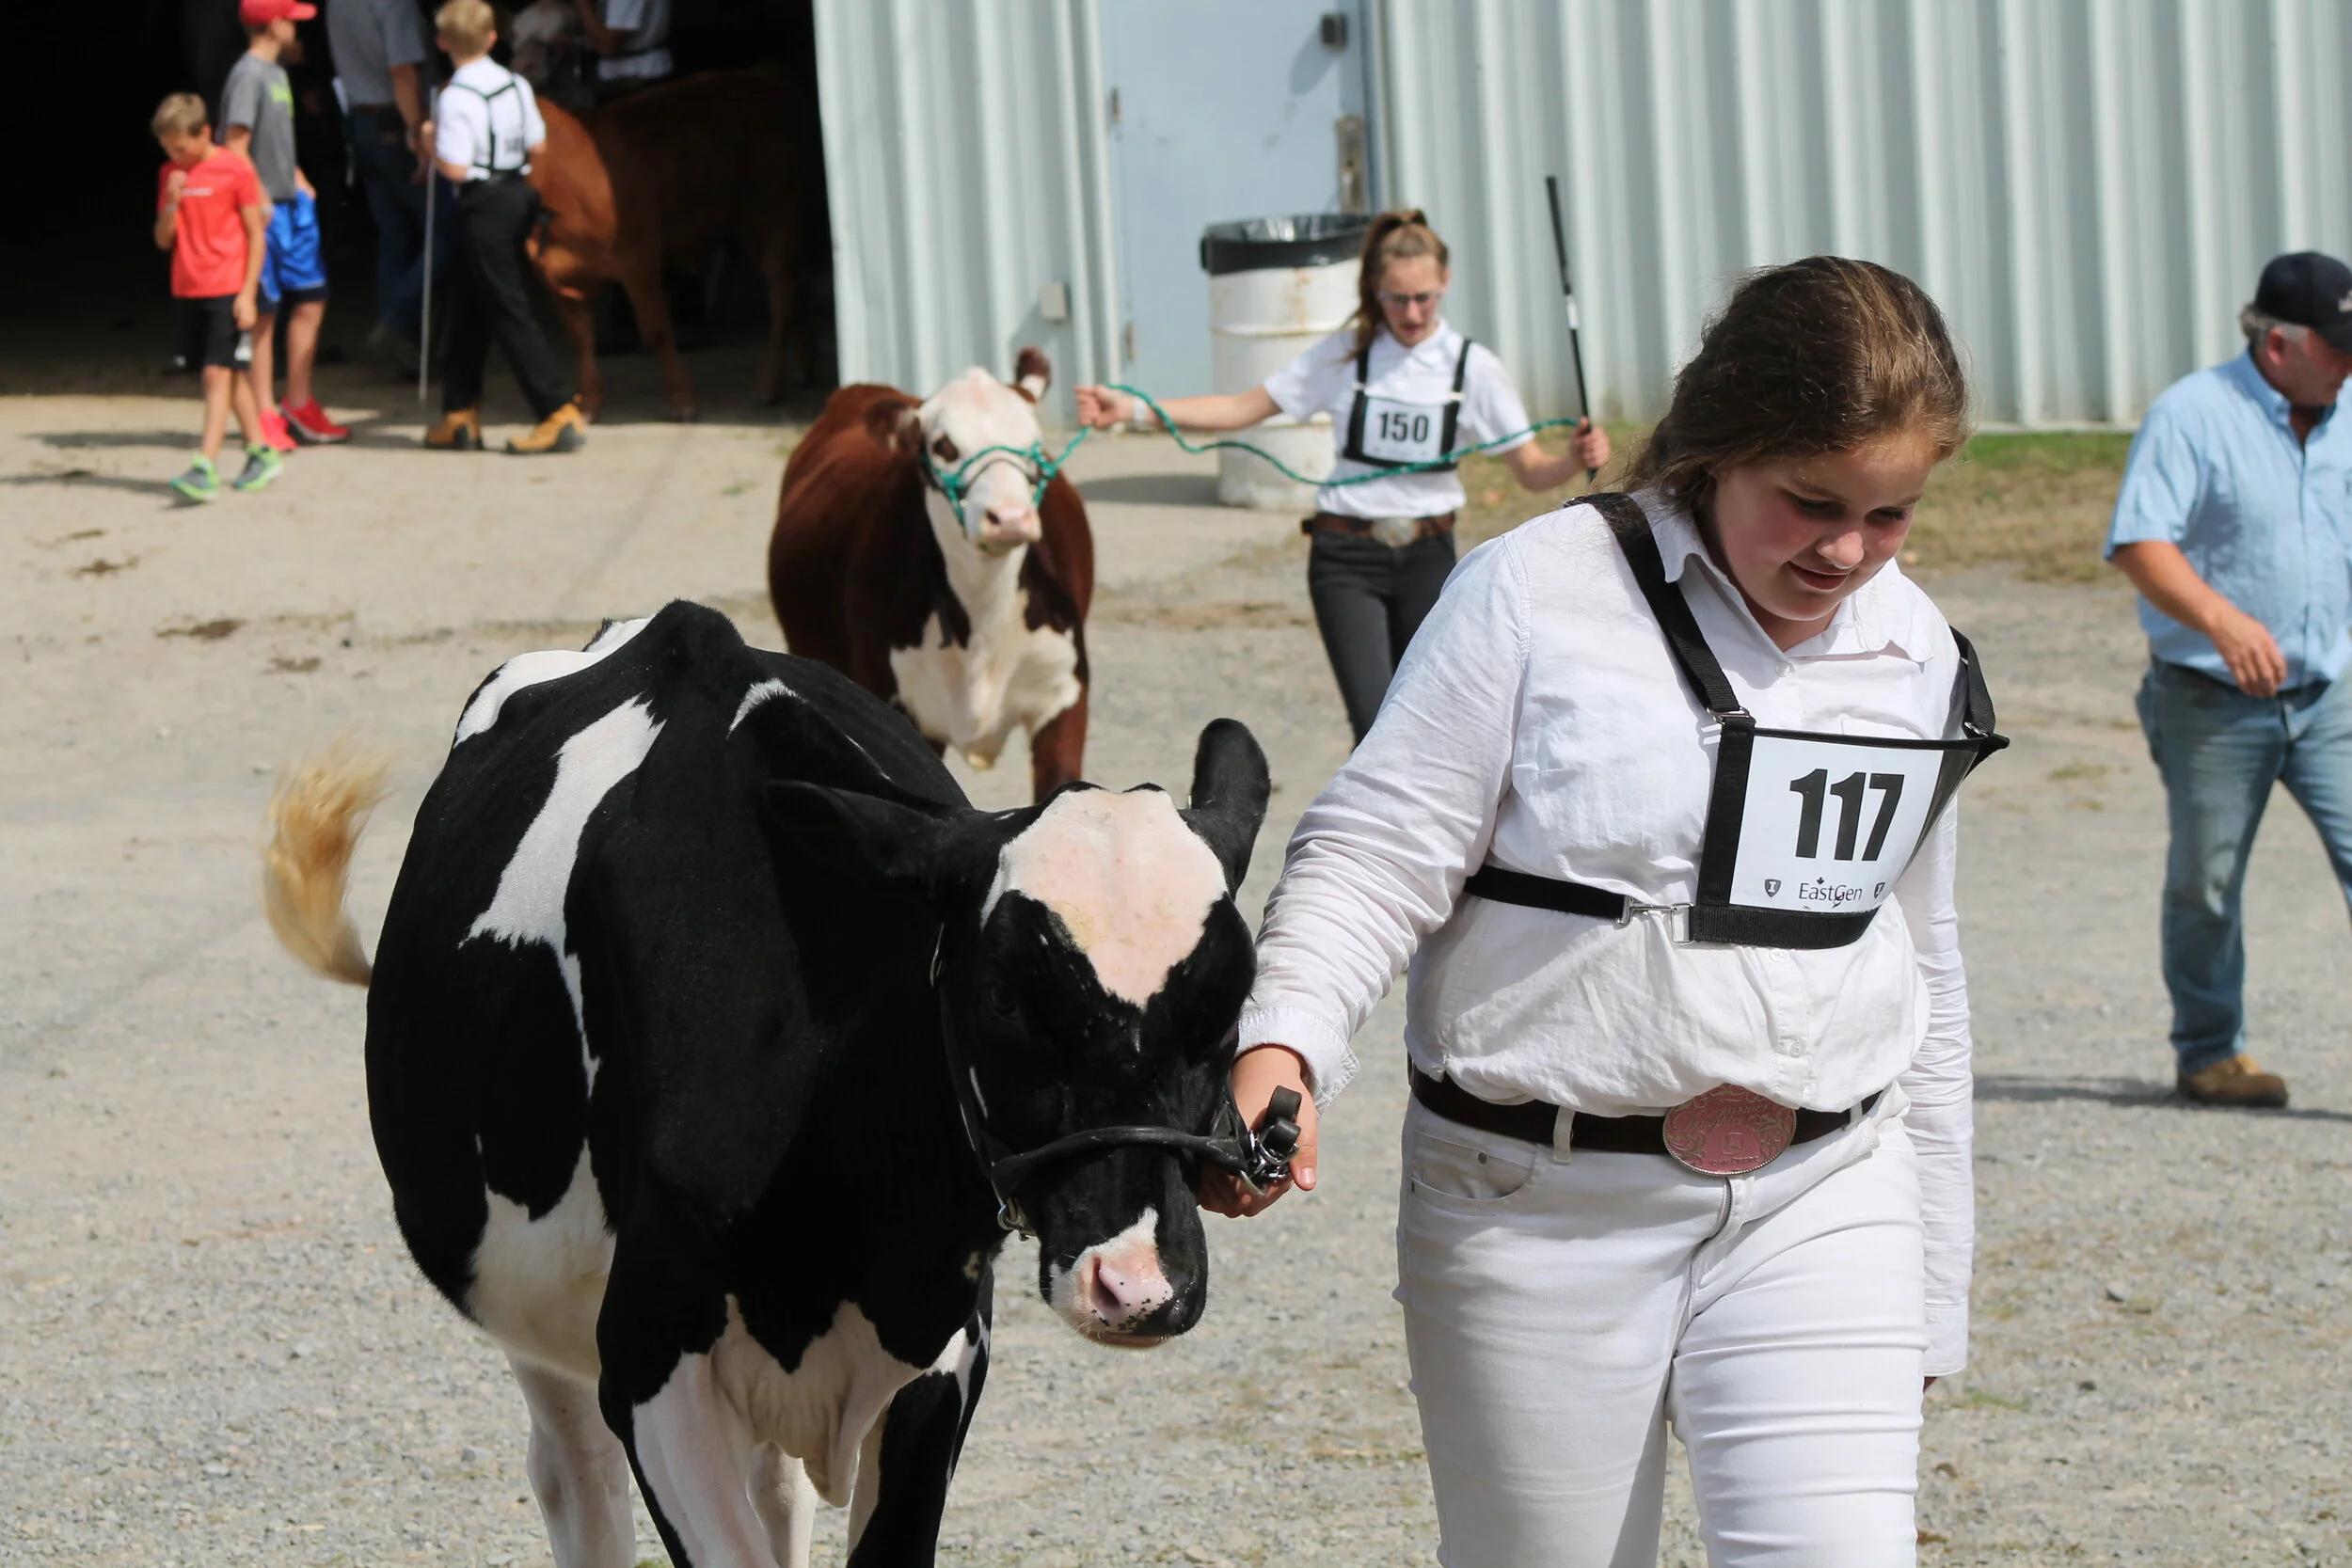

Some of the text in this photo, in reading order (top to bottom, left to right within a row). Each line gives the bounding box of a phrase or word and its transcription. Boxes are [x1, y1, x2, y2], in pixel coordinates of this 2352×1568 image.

[1378, 411, 1429, 443] 150
[1789, 768, 1905, 862] 117
[1799, 882, 1863, 904] EastGen
